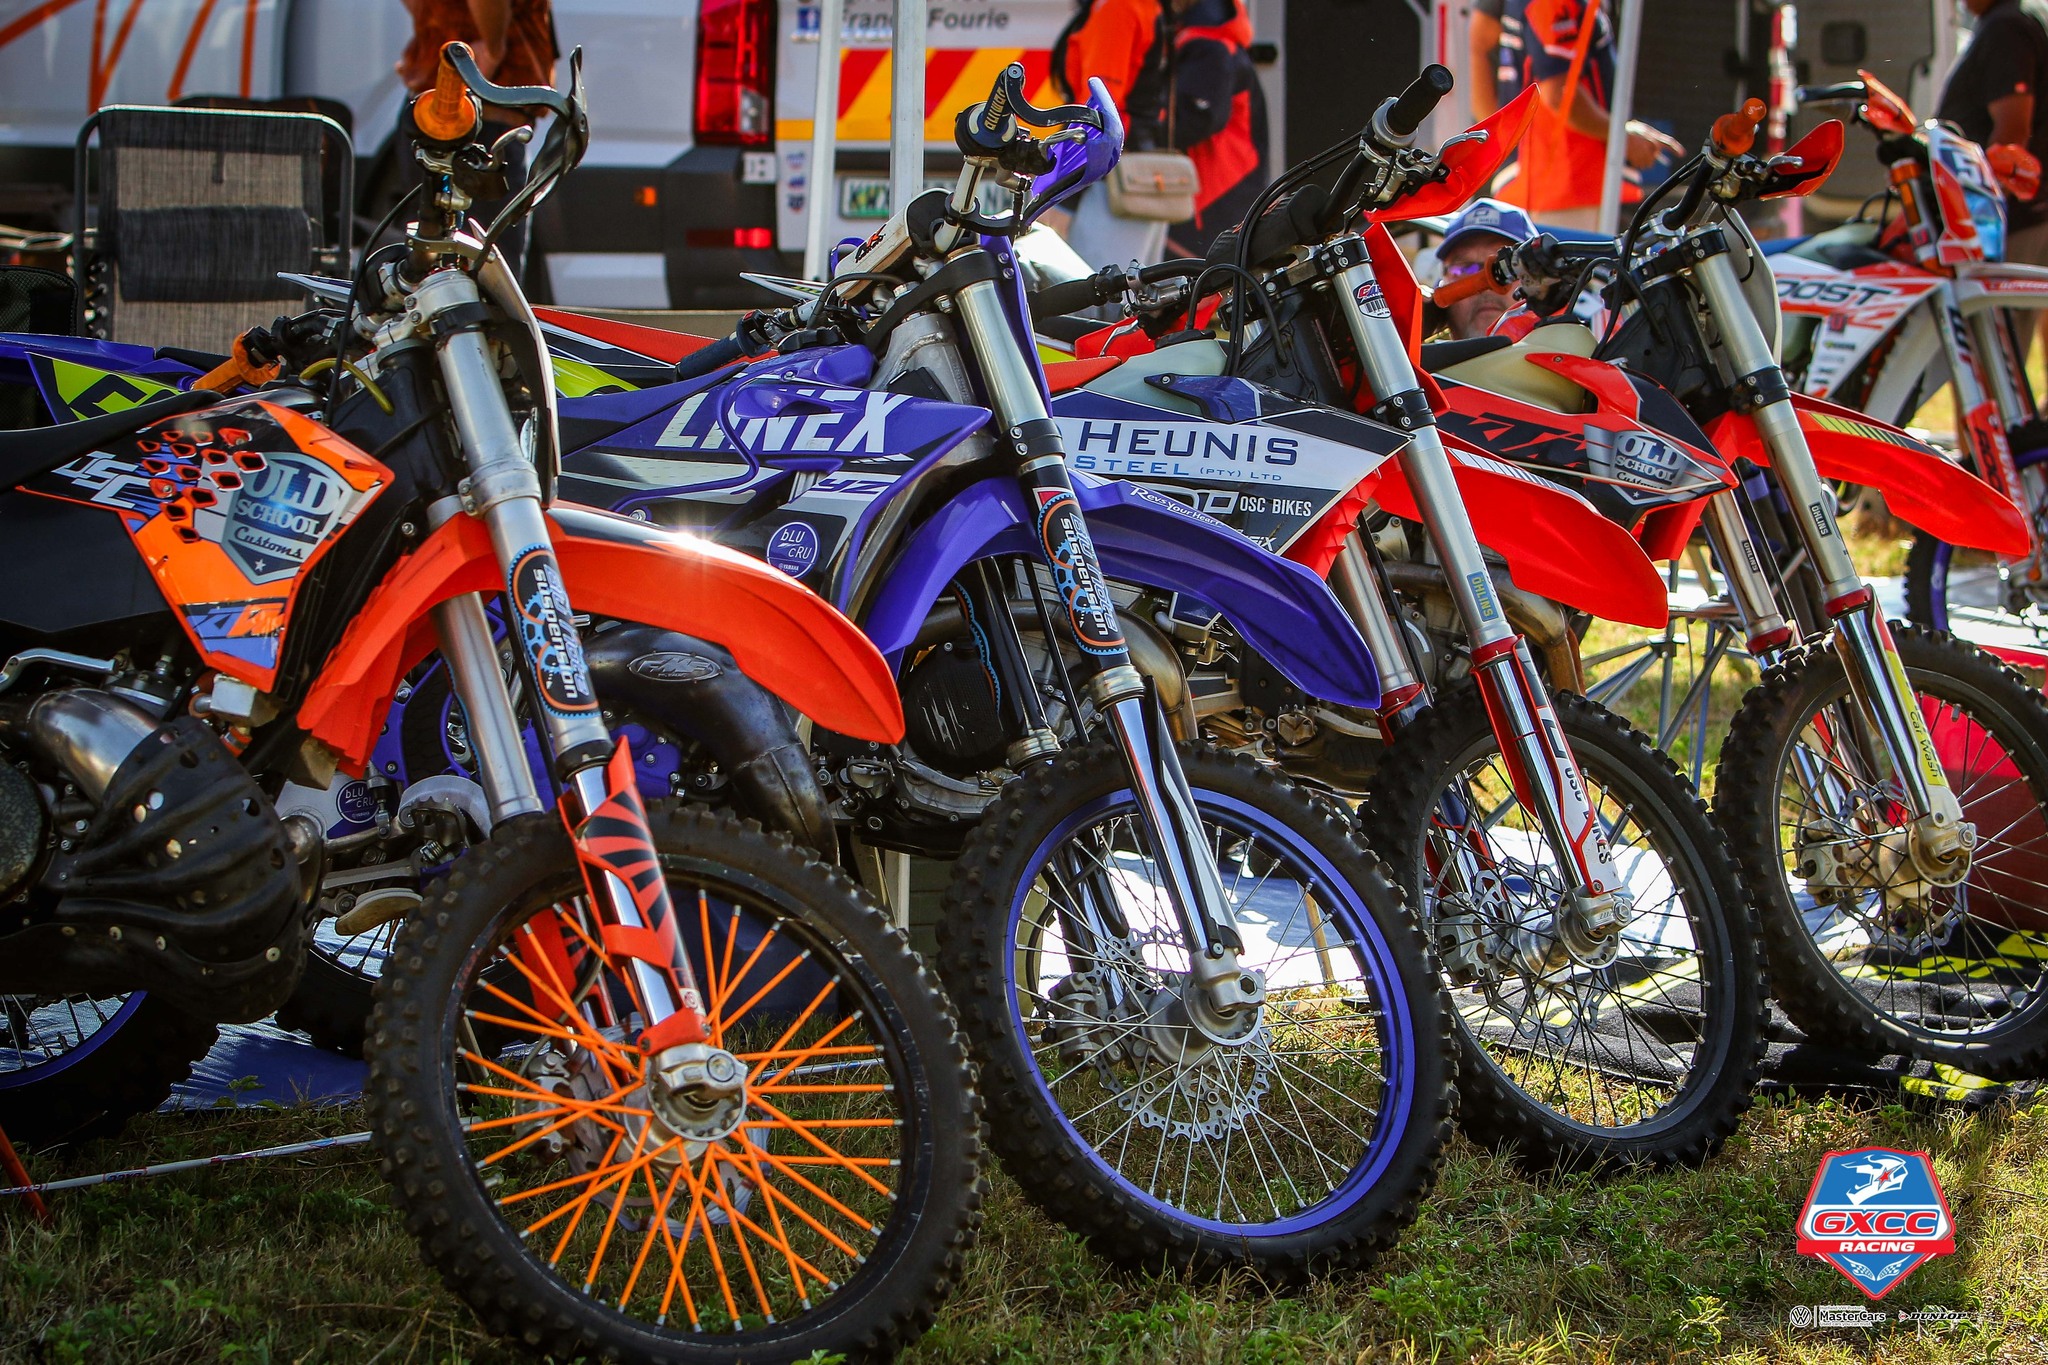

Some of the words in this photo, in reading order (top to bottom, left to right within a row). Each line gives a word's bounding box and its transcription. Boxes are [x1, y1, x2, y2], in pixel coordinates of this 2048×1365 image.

[1078, 421, 1299, 466] HEUNIS
[1618, 433, 1682, 471] OLD
[1074, 455, 1190, 476] STEEL
[1200, 466, 1242, 479] (PTY)
[1614, 455, 1674, 481] SCHOOL
[241, 458, 336, 517] OLD
[818, 478, 890, 495] YZ
[233, 498, 323, 537] SCHOOL
[1240, 496, 1266, 513] OSC
[1272, 498, 1312, 517] BIKES
[233, 525, 305, 560] Customs
[1060, 517, 1109, 636] suspension
[532, 568, 579, 699] suspension
[1909, 711, 1923, 735] Car
[1920, 738, 1939, 778] Wash
